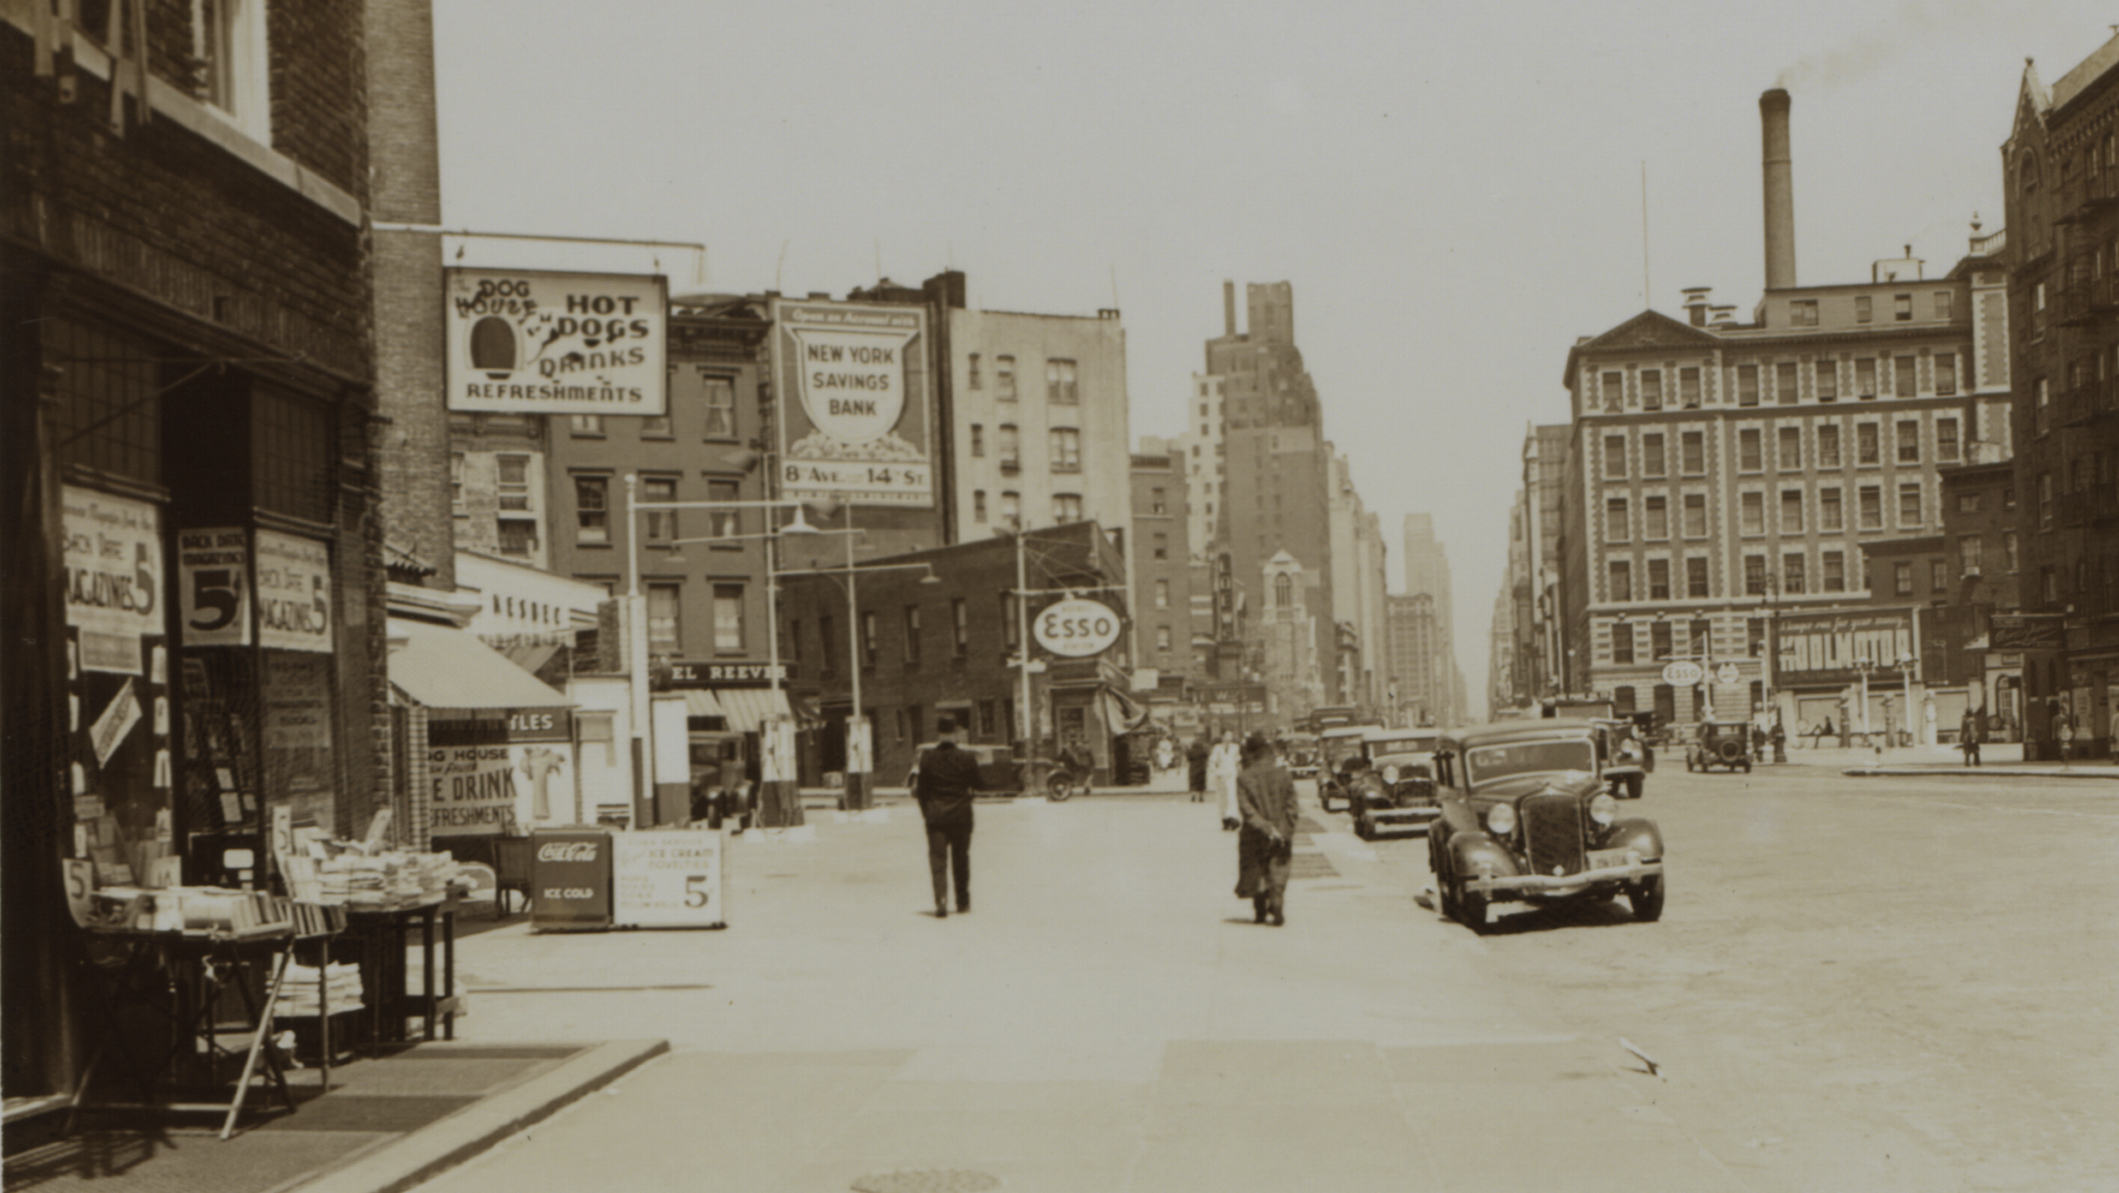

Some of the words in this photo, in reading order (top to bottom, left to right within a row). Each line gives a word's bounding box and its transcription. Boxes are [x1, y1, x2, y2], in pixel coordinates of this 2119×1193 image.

[478, 279, 531, 298] DOG
[566, 294, 640, 315] HOT
[557, 318, 649, 344] DOGS
[807, 344, 844, 363] NEW
[849, 347, 895, 364] YORK
[812, 372, 890, 391] SAVINGS
[467, 384, 643, 403] REFRESHMENTS
[828, 399, 877, 416] BANK
[454, 748, 509, 762] HOUSE
[452, 767, 518, 801] DRINK
[544, 887, 562, 899] ICE
[563, 887, 594, 899] COLD
